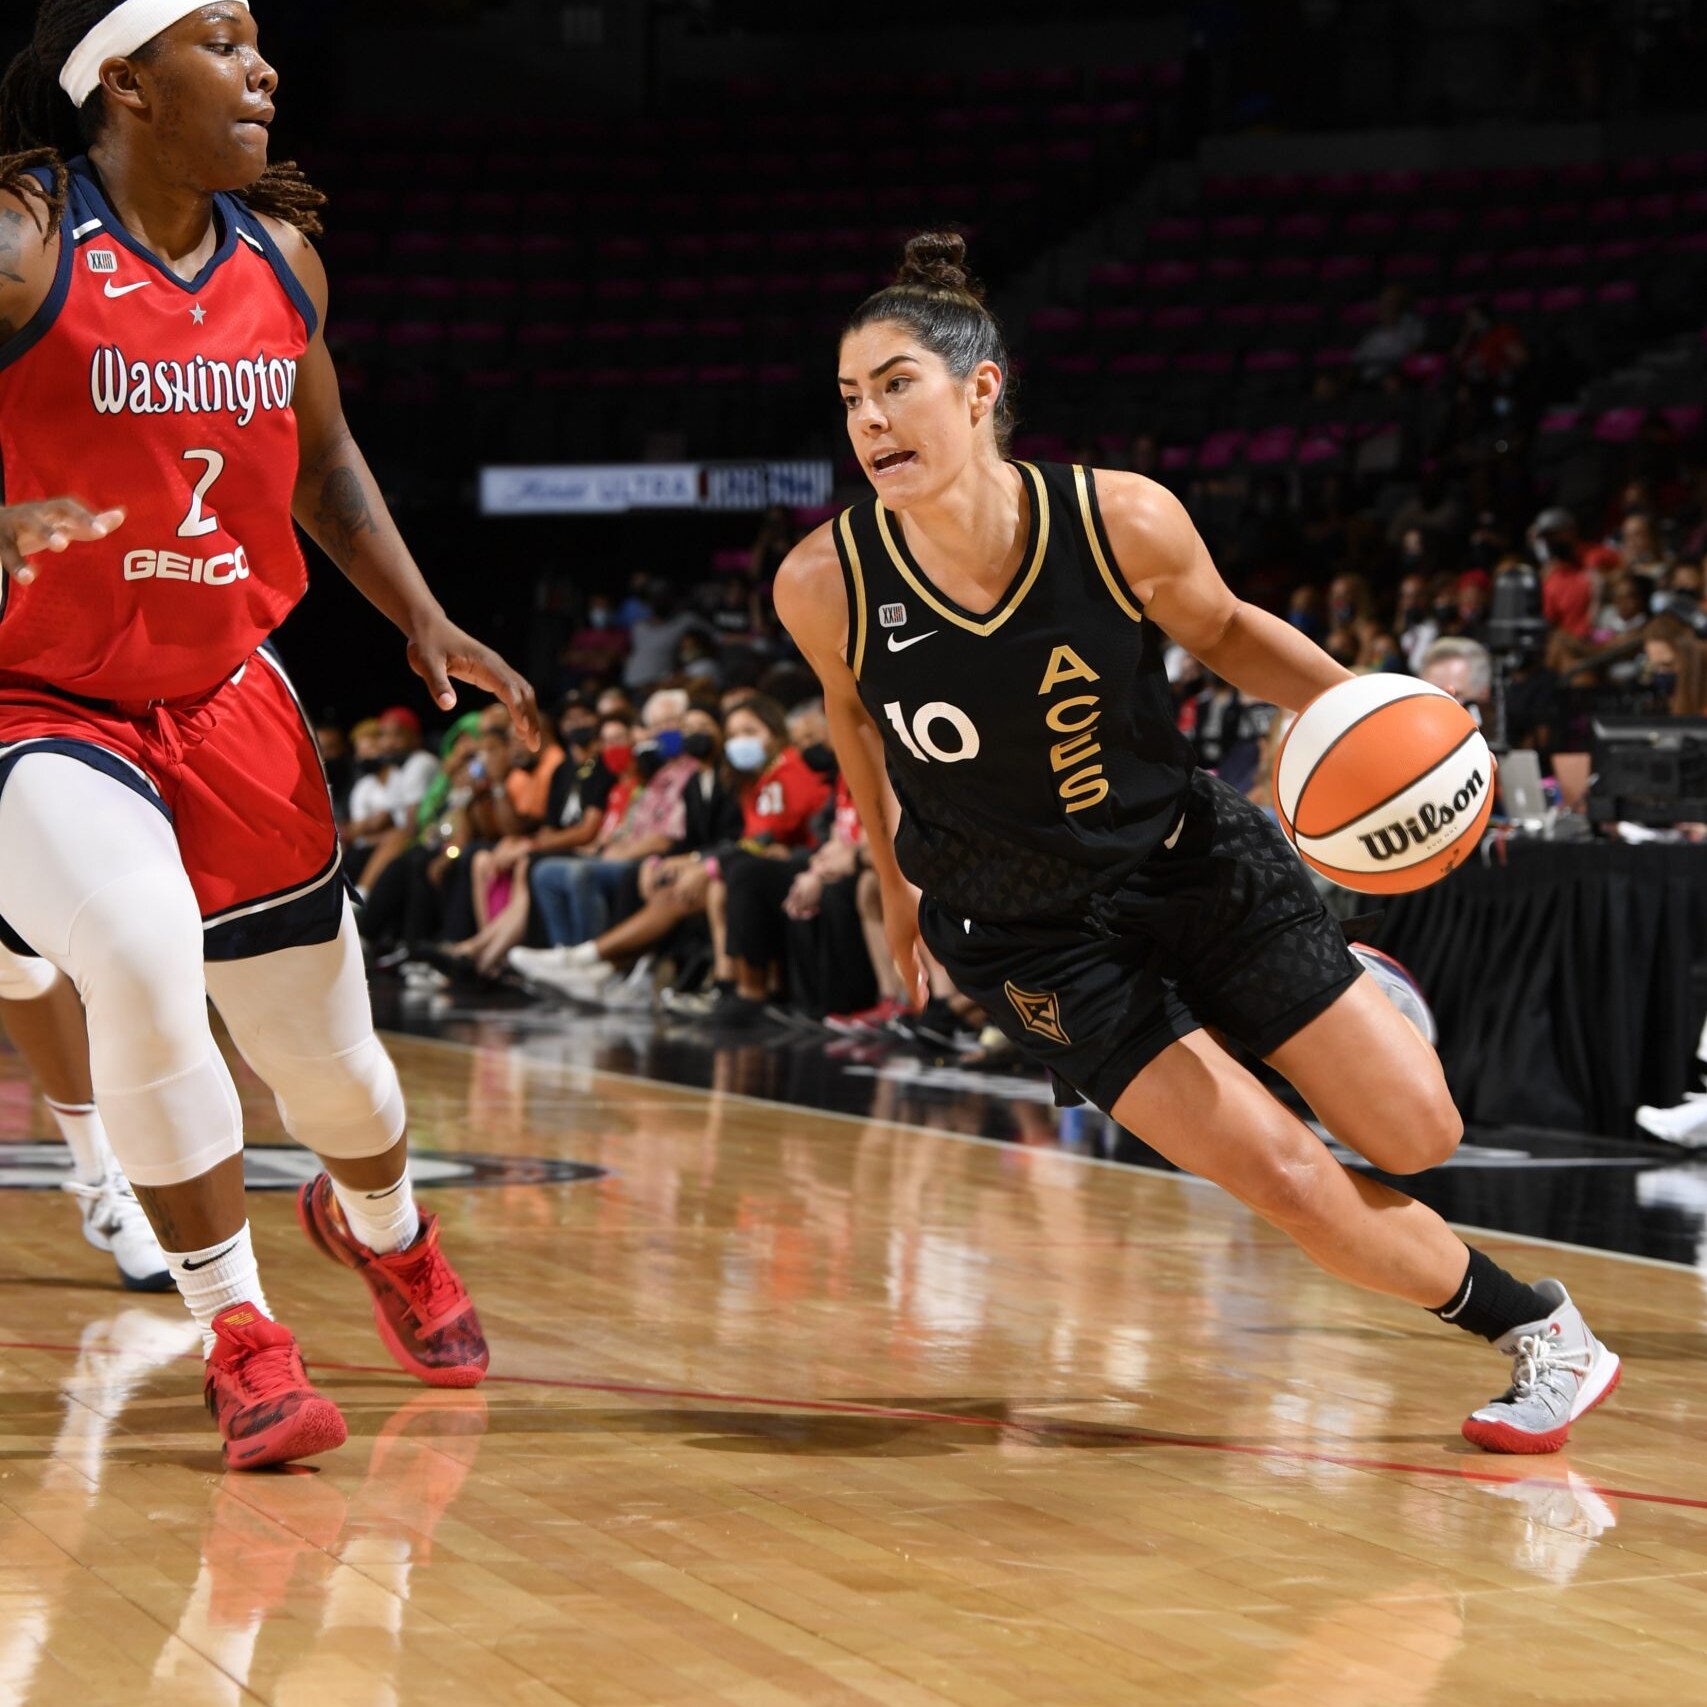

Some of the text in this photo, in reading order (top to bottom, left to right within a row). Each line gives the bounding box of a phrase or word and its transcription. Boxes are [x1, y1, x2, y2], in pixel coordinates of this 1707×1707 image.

[177, 447, 226, 538] 2
[123, 548, 250, 584] GEICO
[884, 701, 980, 763] 10
[1038, 645, 1108, 813] ACES
[1358, 769, 1484, 860] Wilson
